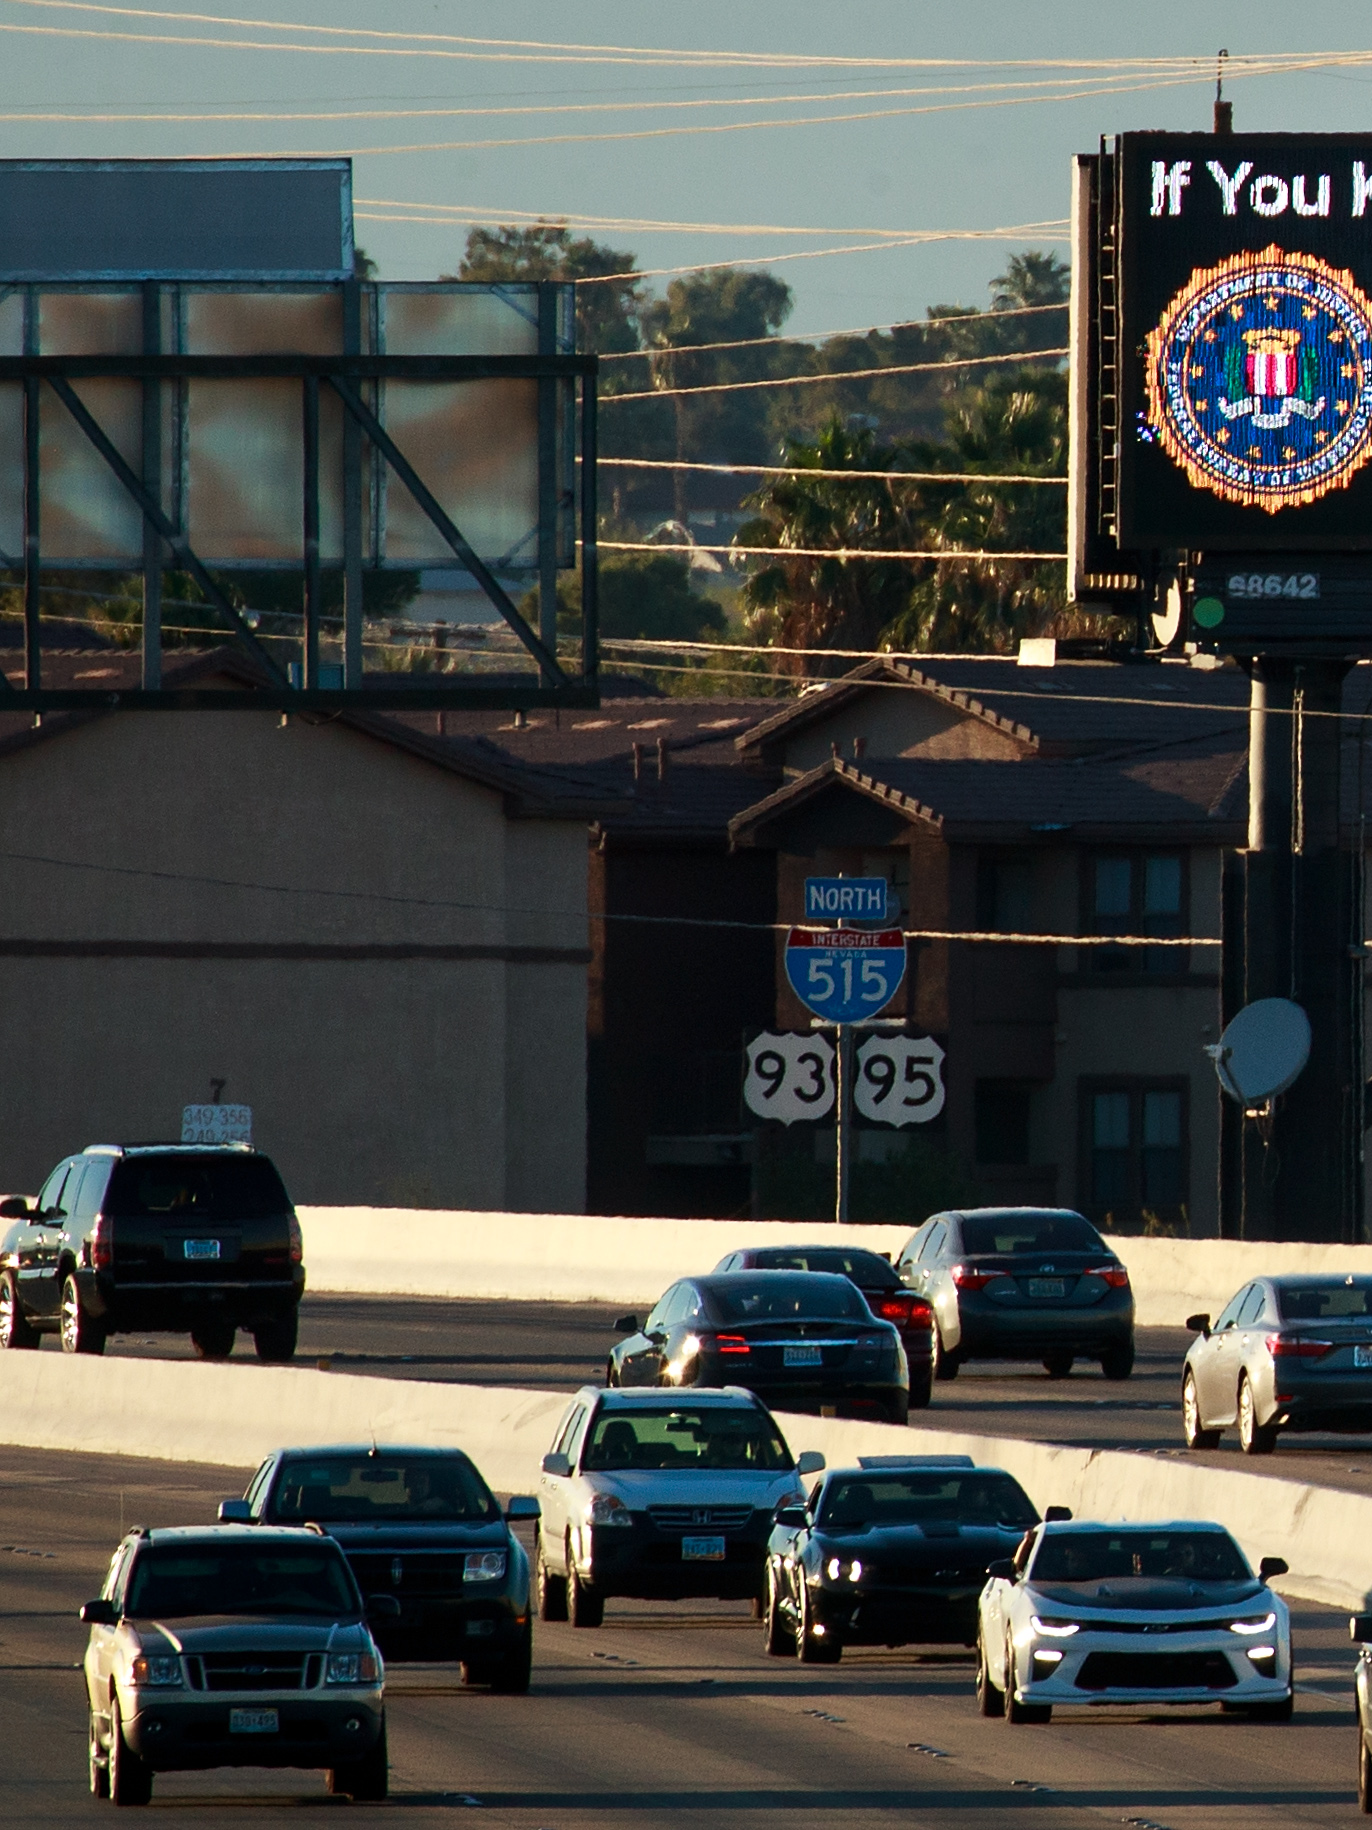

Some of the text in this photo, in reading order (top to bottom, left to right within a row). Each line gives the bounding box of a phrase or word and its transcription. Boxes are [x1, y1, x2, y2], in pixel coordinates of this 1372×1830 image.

[1149, 160, 1192, 216] If
[1205, 160, 1331, 218] You
[810, 885, 882, 911] NORTH
[811, 932, 881, 947] INTERSTATE
[825, 949, 868, 959] NEVADA
[807, 958, 888, 1002] 515
[754, 1050, 826, 1104] 93
[863, 1054, 937, 1107] 95
